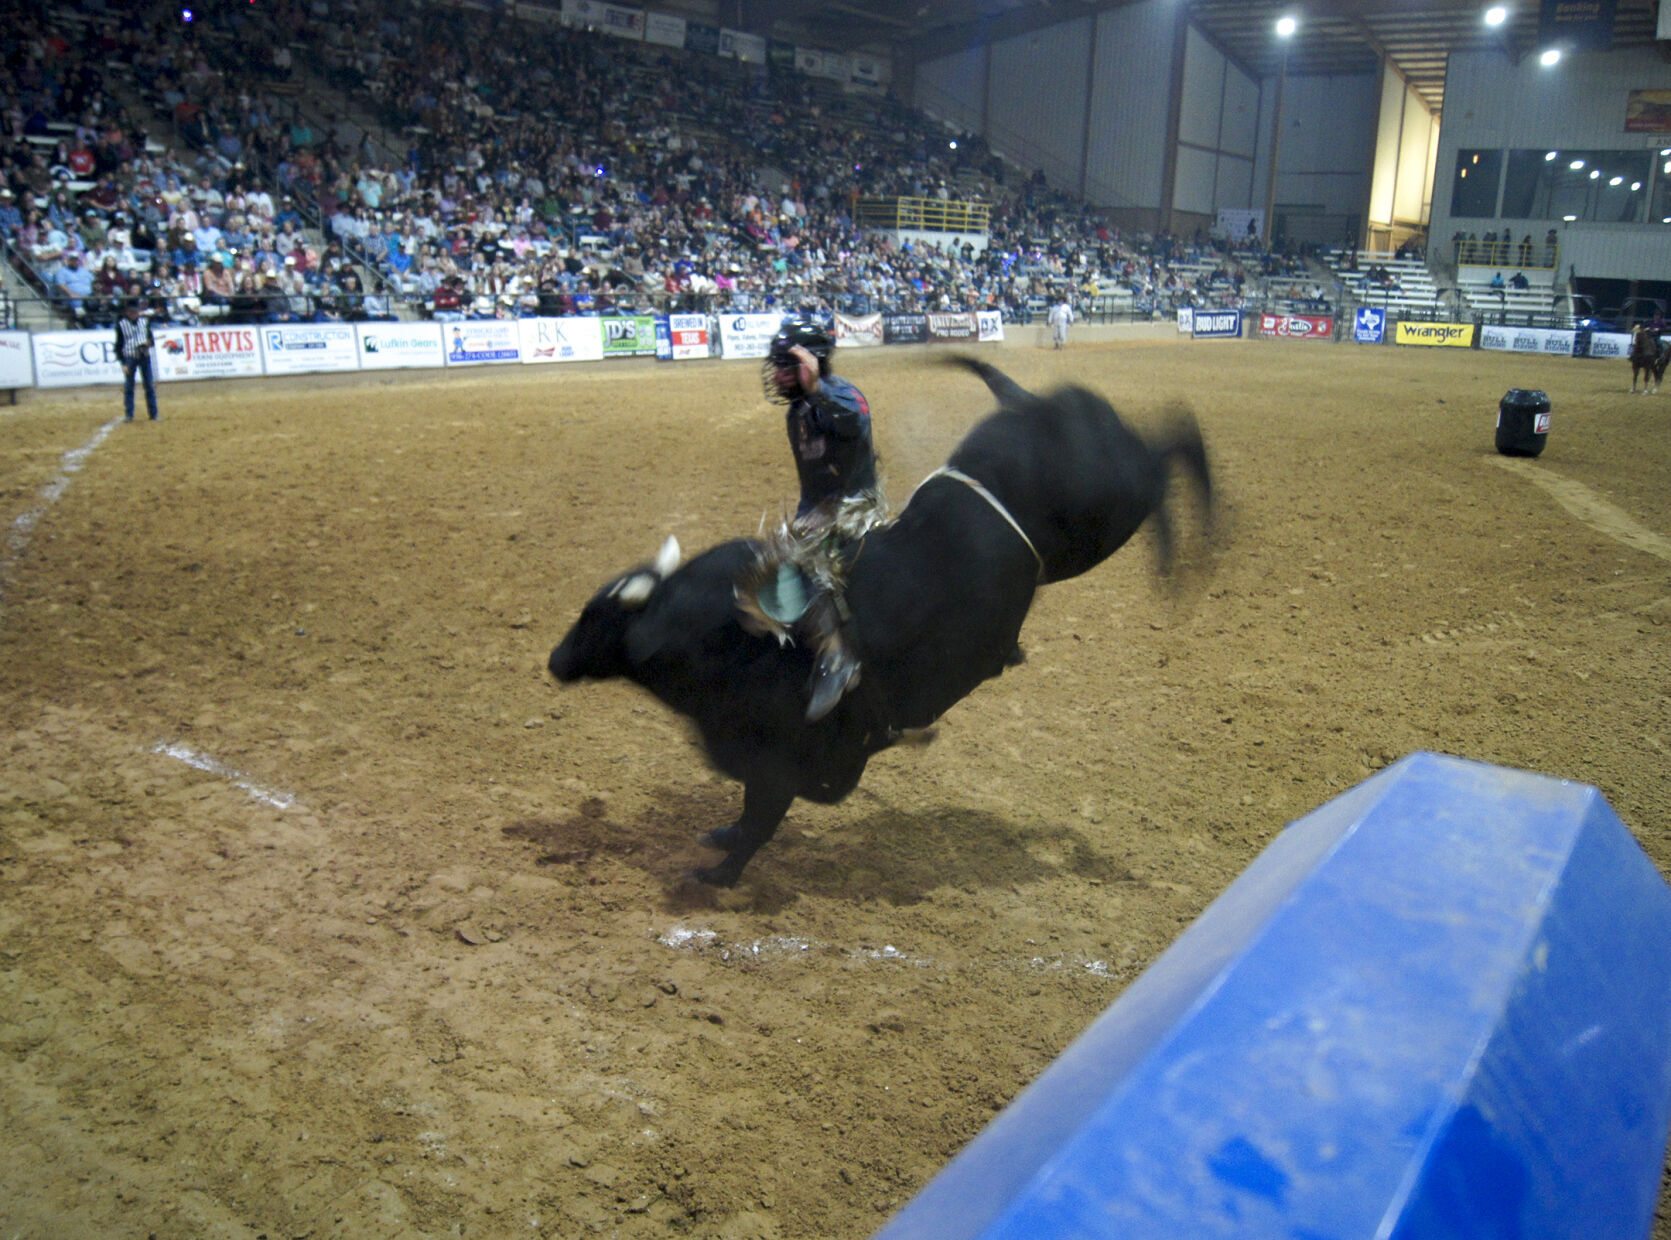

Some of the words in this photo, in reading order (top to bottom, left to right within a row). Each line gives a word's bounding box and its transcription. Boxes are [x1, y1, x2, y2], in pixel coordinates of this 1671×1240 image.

[673, 317, 697, 329] BREWED
[1196, 315, 1211, 331] BUD
[1212, 315, 1236, 330] LIGHT
[603, 319, 637, 348] JD'S
[681, 332, 700, 345] TEXAS
[936, 328, 949, 337] PRO
[950, 328, 970, 337] RODEO
[1403, 324, 1465, 343] Wrangler
[380, 337, 409, 349] Lufkin
[410, 339, 438, 348] Gears
[1483, 335, 1506, 344] BULL
[1513, 336, 1538, 345] BULL
[1545, 338, 1571, 347] BULL
[184, 331, 253, 361] JARVIS
[1593, 342, 1619, 351] BULL
